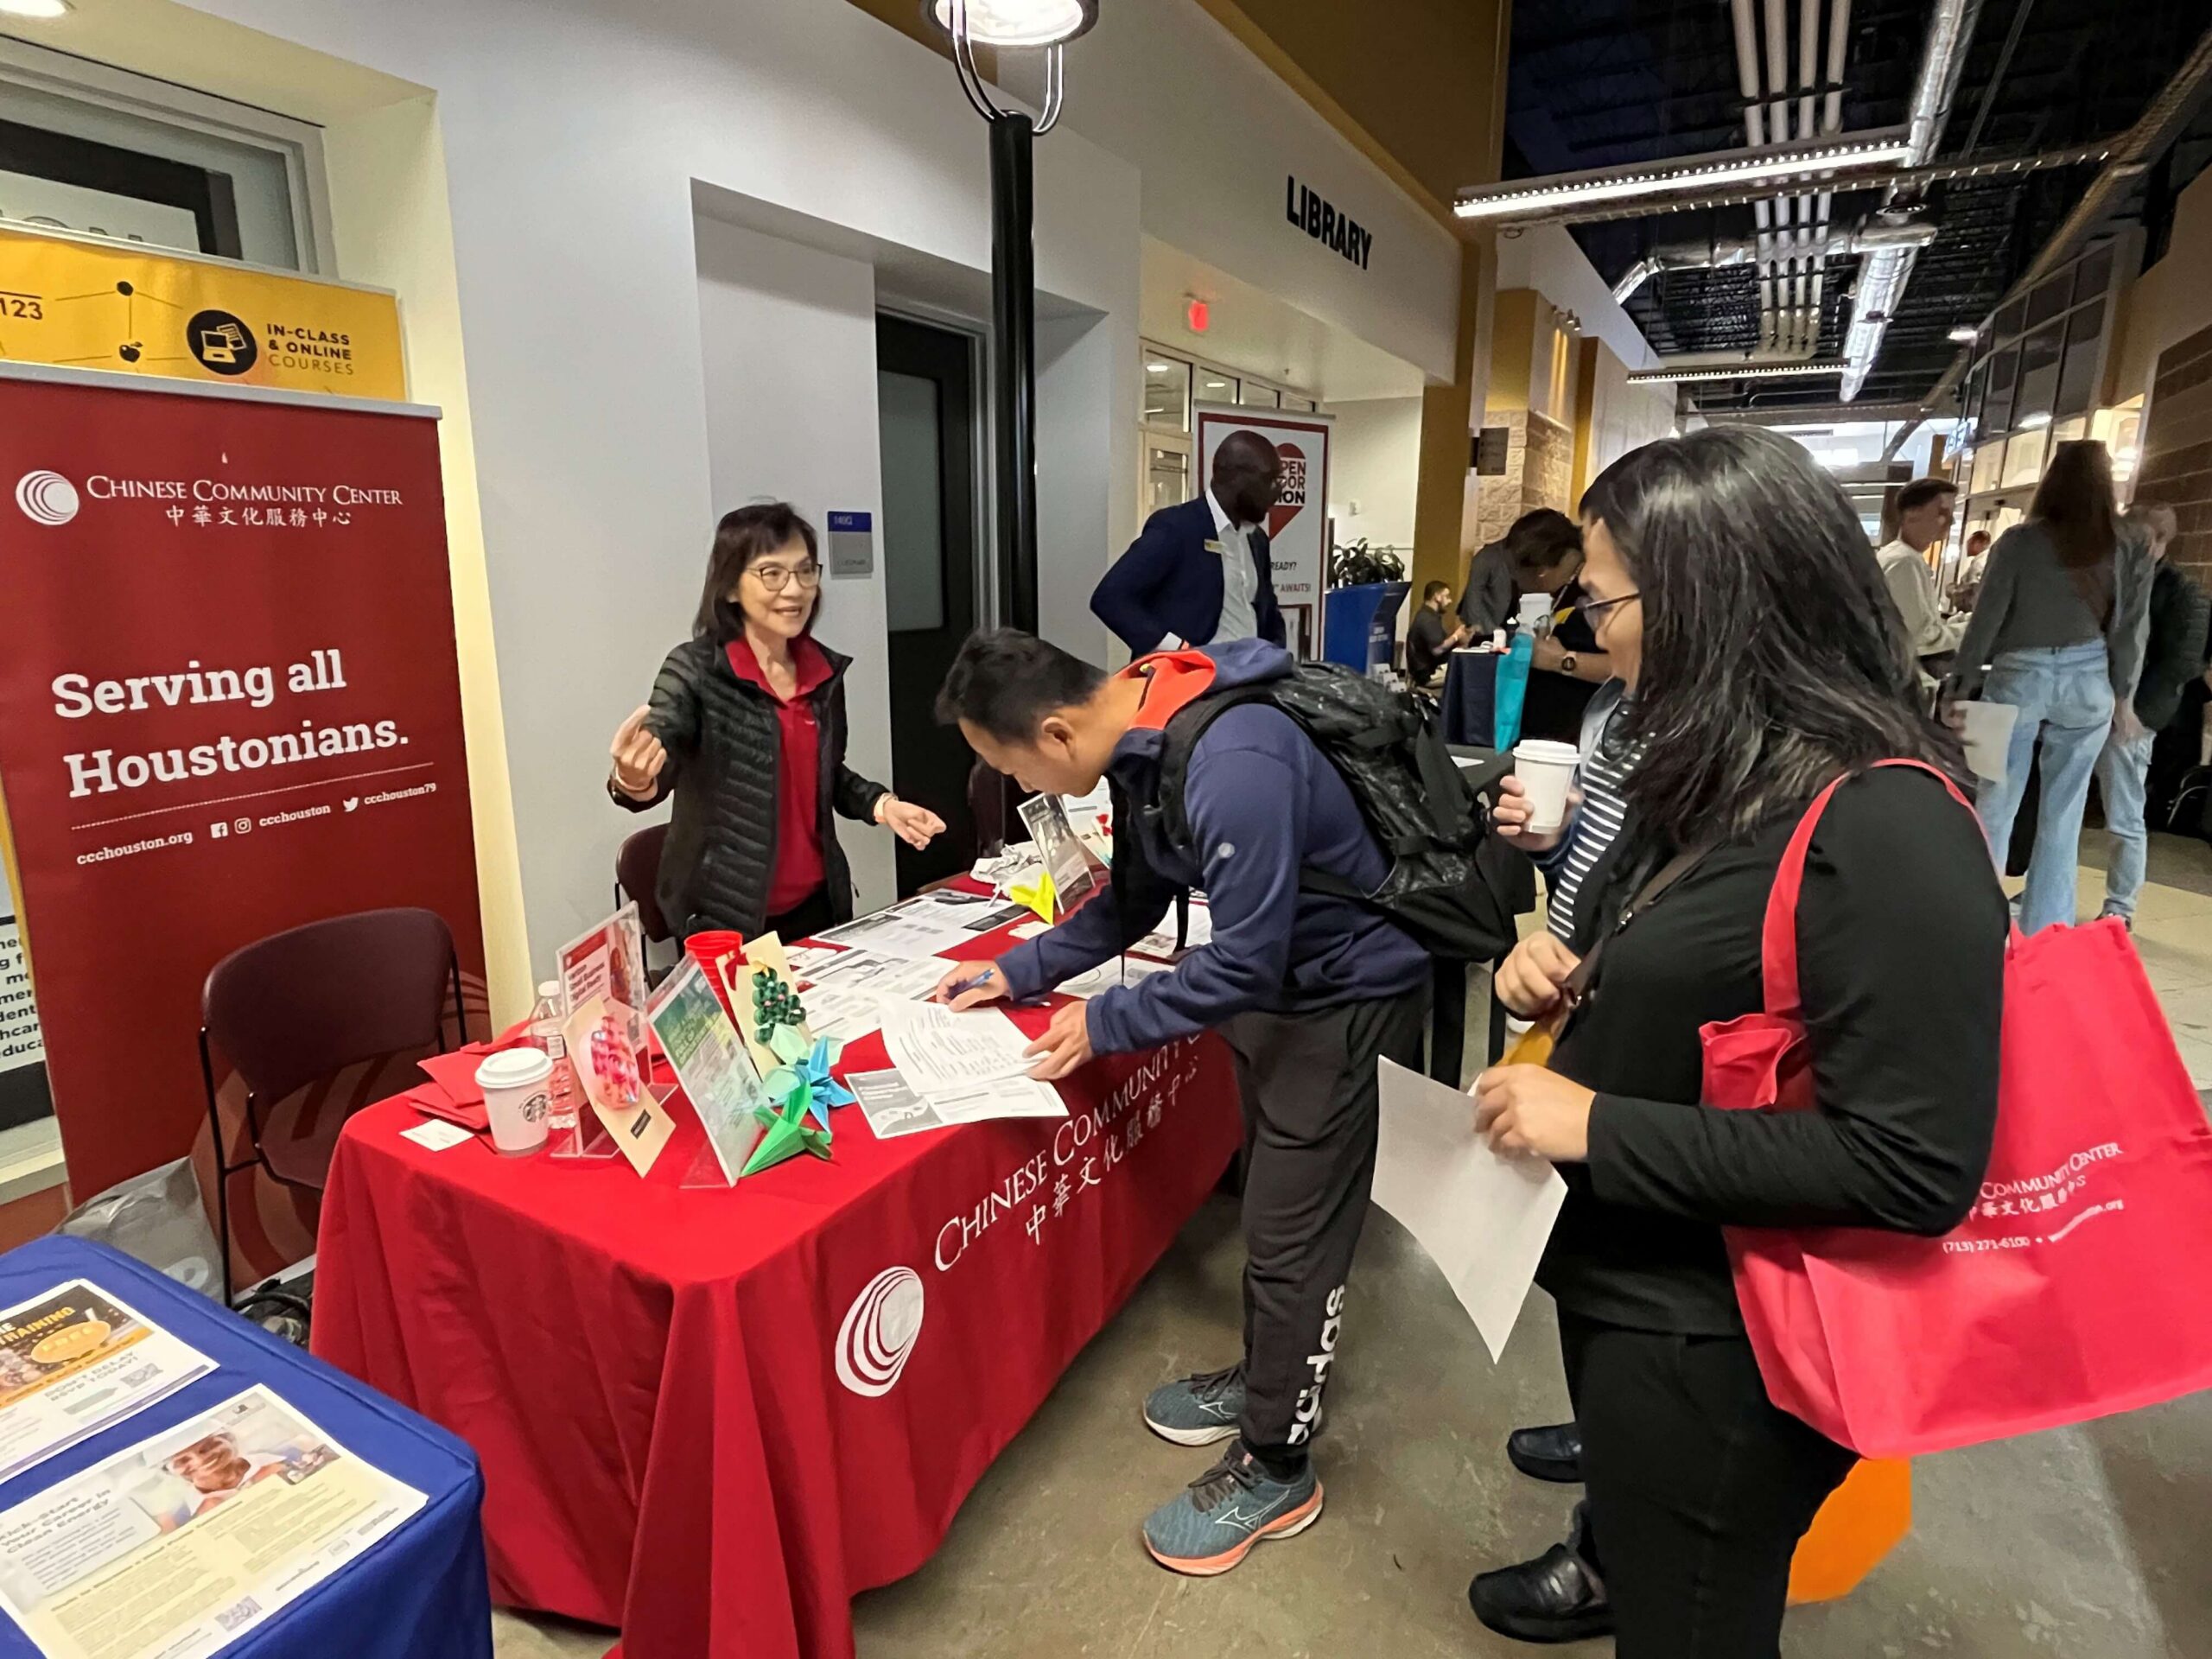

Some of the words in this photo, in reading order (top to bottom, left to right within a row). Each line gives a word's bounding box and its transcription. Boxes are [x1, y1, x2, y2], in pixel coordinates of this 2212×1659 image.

[1287, 175, 1372, 270] LIBRARY
[267, 323, 350, 345] IN-CLASS
[269, 340, 279, 350] &
[286, 342, 352, 360] ONLINE
[269, 354, 353, 375] COURSES
[86, 474, 187, 500] CHINESE
[193, 480, 327, 503] COMMUNITY
[333, 485, 403, 505] CENTER
[1281, 461, 1306, 476] PEN
[166, 505, 352, 528] 中華文化服務中心
[51, 660, 274, 719] Serving
[288, 649, 346, 691] all
[63, 719, 409, 798] Houstonians.
[76, 830, 194, 865] ccchouston.org
[259, 804, 331, 828] ccchouston
[364, 783, 437, 805] ccchouston79
[935, 1149, 1047, 1272] CHINESE
[1053, 1039, 1180, 1166] COMMUNITY
[1287, 1284, 1344, 1445] adidas
